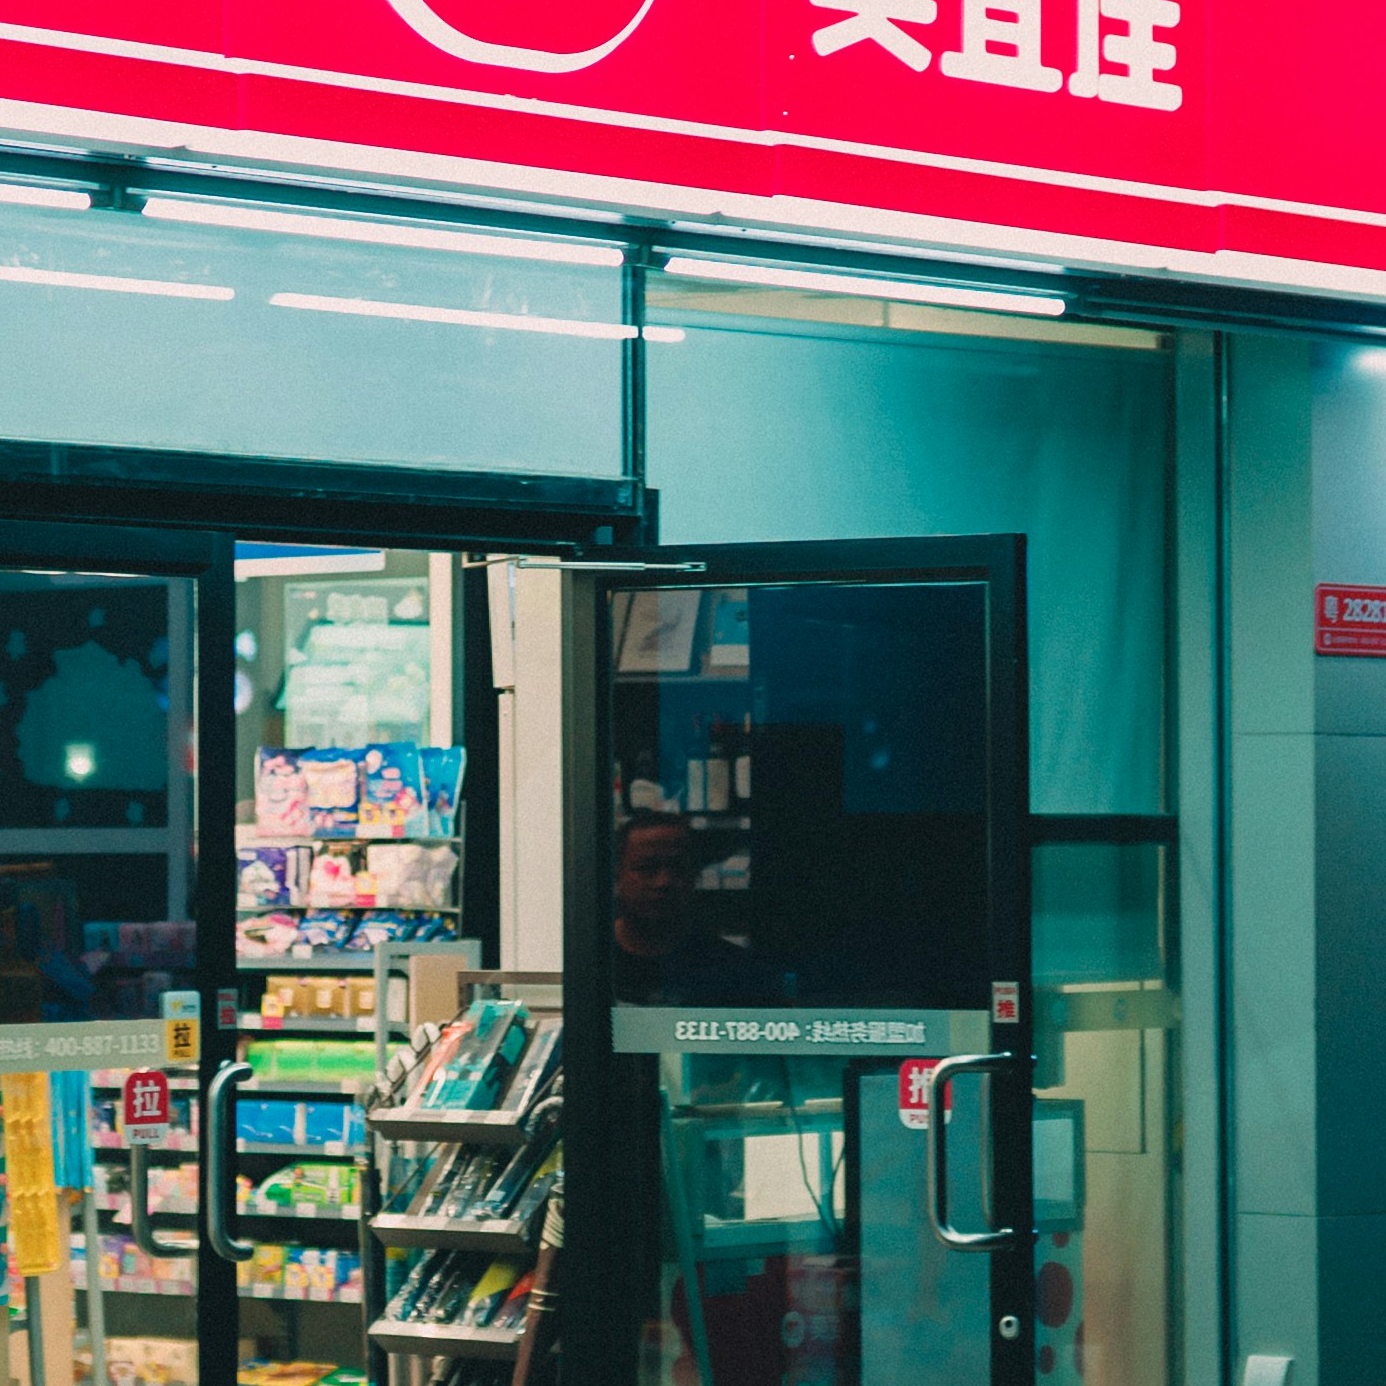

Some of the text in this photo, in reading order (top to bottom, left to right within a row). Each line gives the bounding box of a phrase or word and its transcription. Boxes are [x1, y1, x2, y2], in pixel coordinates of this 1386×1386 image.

[44, 1033, 161, 1057] 400-887-1133
[133, 1079, 161, 1118] 拉
[132, 1129, 160, 1140] PULL
